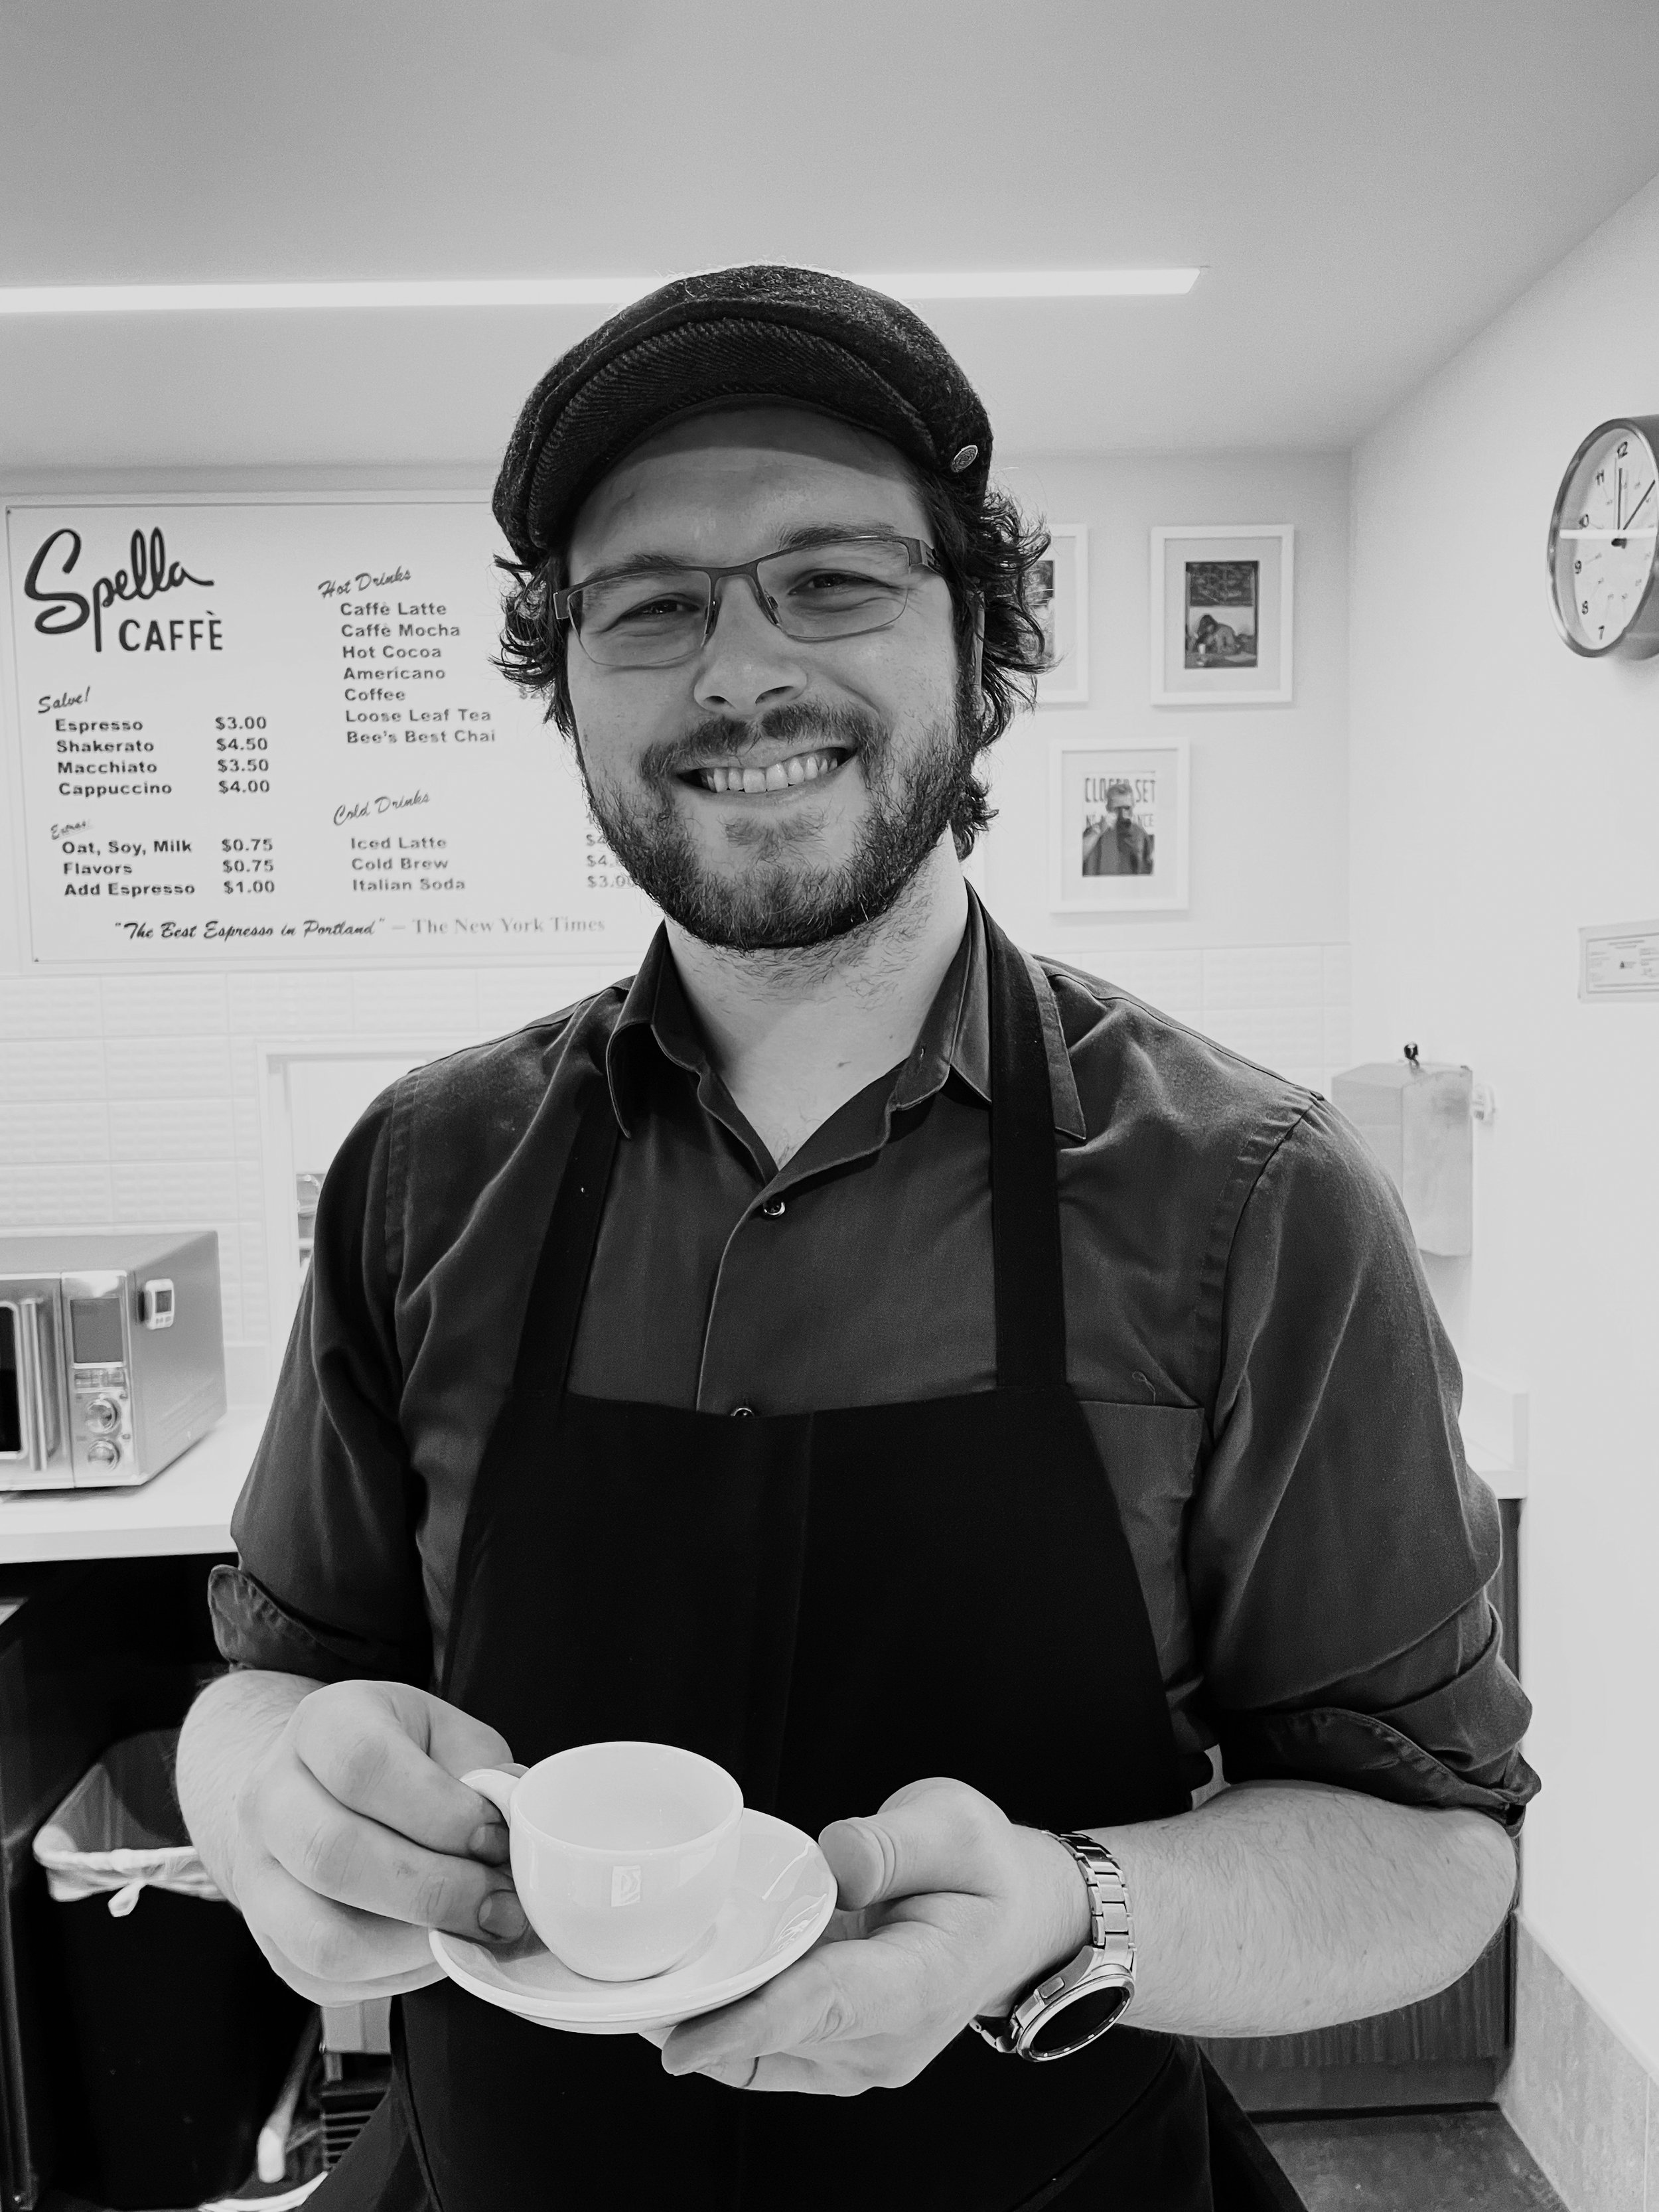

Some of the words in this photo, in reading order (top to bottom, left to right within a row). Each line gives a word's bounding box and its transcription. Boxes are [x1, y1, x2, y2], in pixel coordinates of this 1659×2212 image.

[25, 527, 214, 652] Spella
[317, 579, 351, 599] Hot
[354, 565, 411, 591] Drinks
[397, 602, 447, 616] Latte
[118, 610, 223, 652] CAFFÈ
[399, 623, 460, 637] Mocha
[342, 646, 375, 659] Hot
[382, 644, 441, 658] Cocoa
[343, 667, 445, 680] Americano
[37, 686, 91, 715] Salve!
[344, 688, 405, 701] Coffee
[345, 709, 401, 723] Loose
[409, 708, 449, 722] Leaf
[457, 708, 491, 721] Tea
[55, 718, 143, 735] Espresso
[215, 716, 267, 731] $3.00
[346, 730, 397, 743] Bee's
[405, 730, 446, 743] Best
[454, 729, 495, 743] Chai
[56, 739, 155, 753] Shakerato
[216, 737, 268, 752] $4.50
[58, 761, 157, 774] Macchiato
[217, 759, 269, 773] $3.50
[58, 782, 173, 798] Cappuccino
[218, 780, 270, 794] $4.00
[333, 801, 370, 826] Cold
[374, 789, 429, 814] Drinks
[62, 841, 101, 856] Oat,
[108, 840, 146, 857] Soy,
[153, 840, 192, 853] Milk
[221, 838, 273, 853] $0.75
[351, 837, 391, 849] Iced
[398, 837, 446, 849] Latte
[63, 862, 133, 875] Flavors
[222, 859, 274, 874] $0.75
[351, 857, 393, 871] Cold
[400, 857, 448, 870] Brew
[64, 883, 100, 896] Add
[108, 882, 195, 898] Espresso
[223, 880, 275, 895] $1.00
[352, 879, 412, 891] Italian
[419, 877, 465, 891] Soda
[160, 921, 197, 938] Best
[203, 920, 273, 942] Espresso
[280, 923, 297, 937] in
[412, 919, 447, 934] The
[454, 918, 494, 934] New
[500, 917, 545, 933] York
[550, 917, 605, 932] Times
